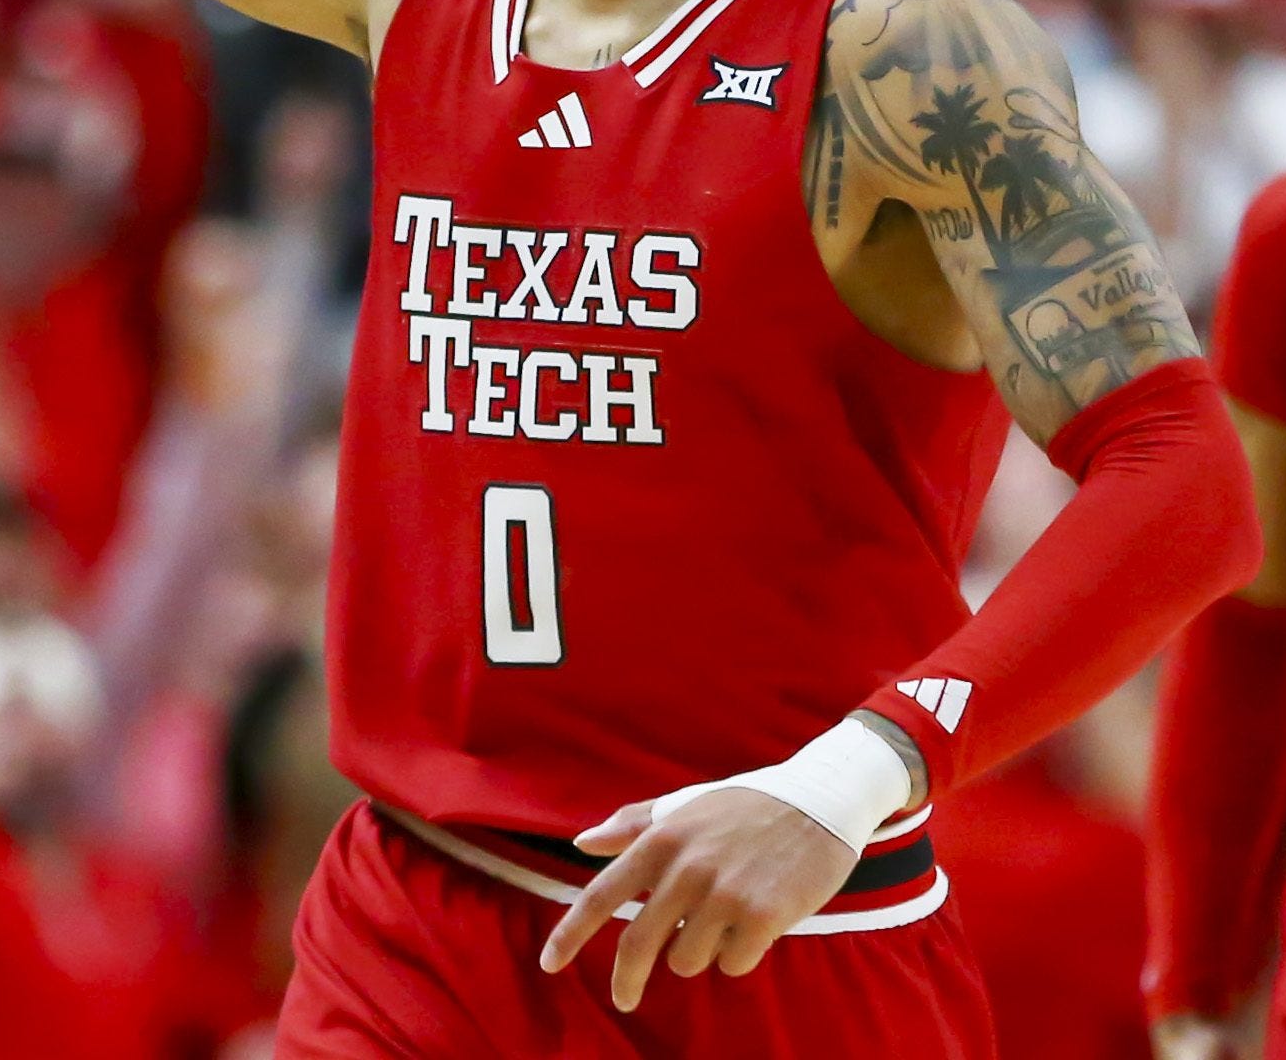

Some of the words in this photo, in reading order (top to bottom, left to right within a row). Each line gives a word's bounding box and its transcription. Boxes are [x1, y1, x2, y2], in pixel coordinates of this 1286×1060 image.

[701, 61, 783, 106] XII
[393, 193, 701, 331] TEXAS
[408, 313, 664, 445] TECH
[482, 485, 563, 665] 0
